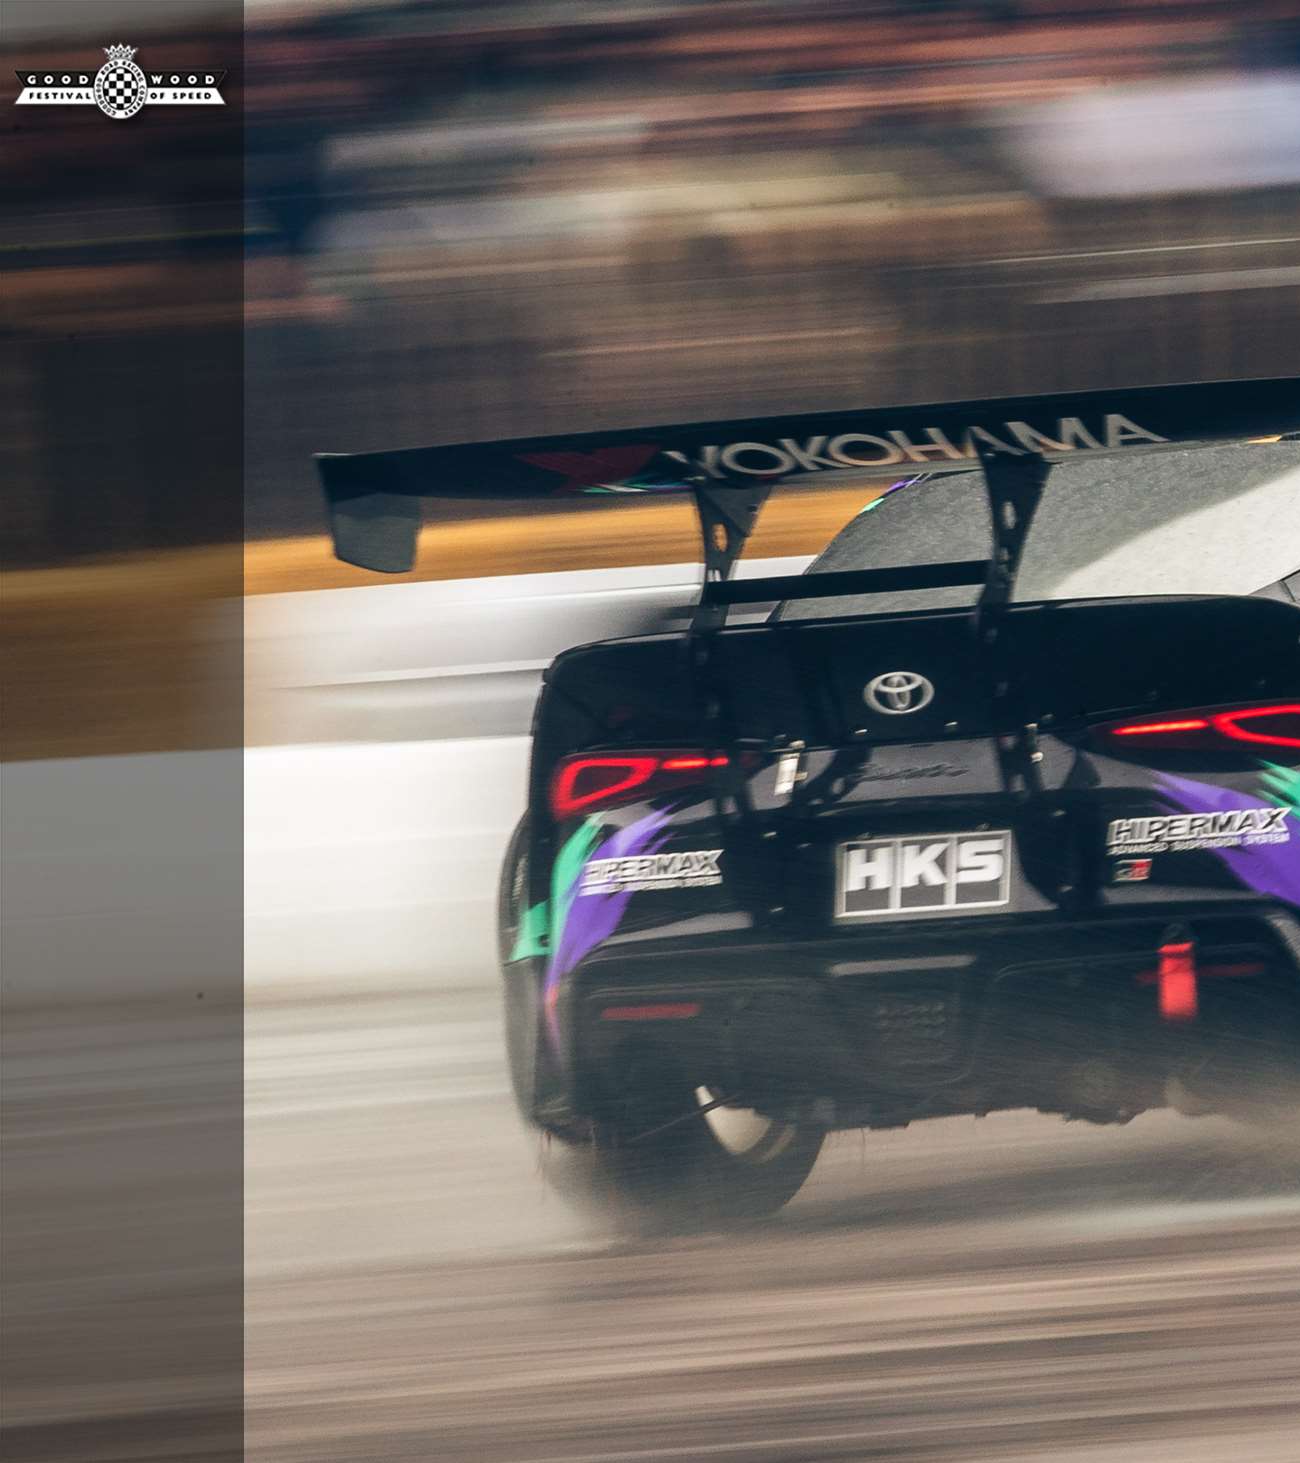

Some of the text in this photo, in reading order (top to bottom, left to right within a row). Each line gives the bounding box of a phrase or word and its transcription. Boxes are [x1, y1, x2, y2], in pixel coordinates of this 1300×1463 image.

[665, 413, 1168, 479] YOKOHAMA
[1106, 807, 1293, 846] HIPERMAX
[843, 838, 1004, 893] HKS
